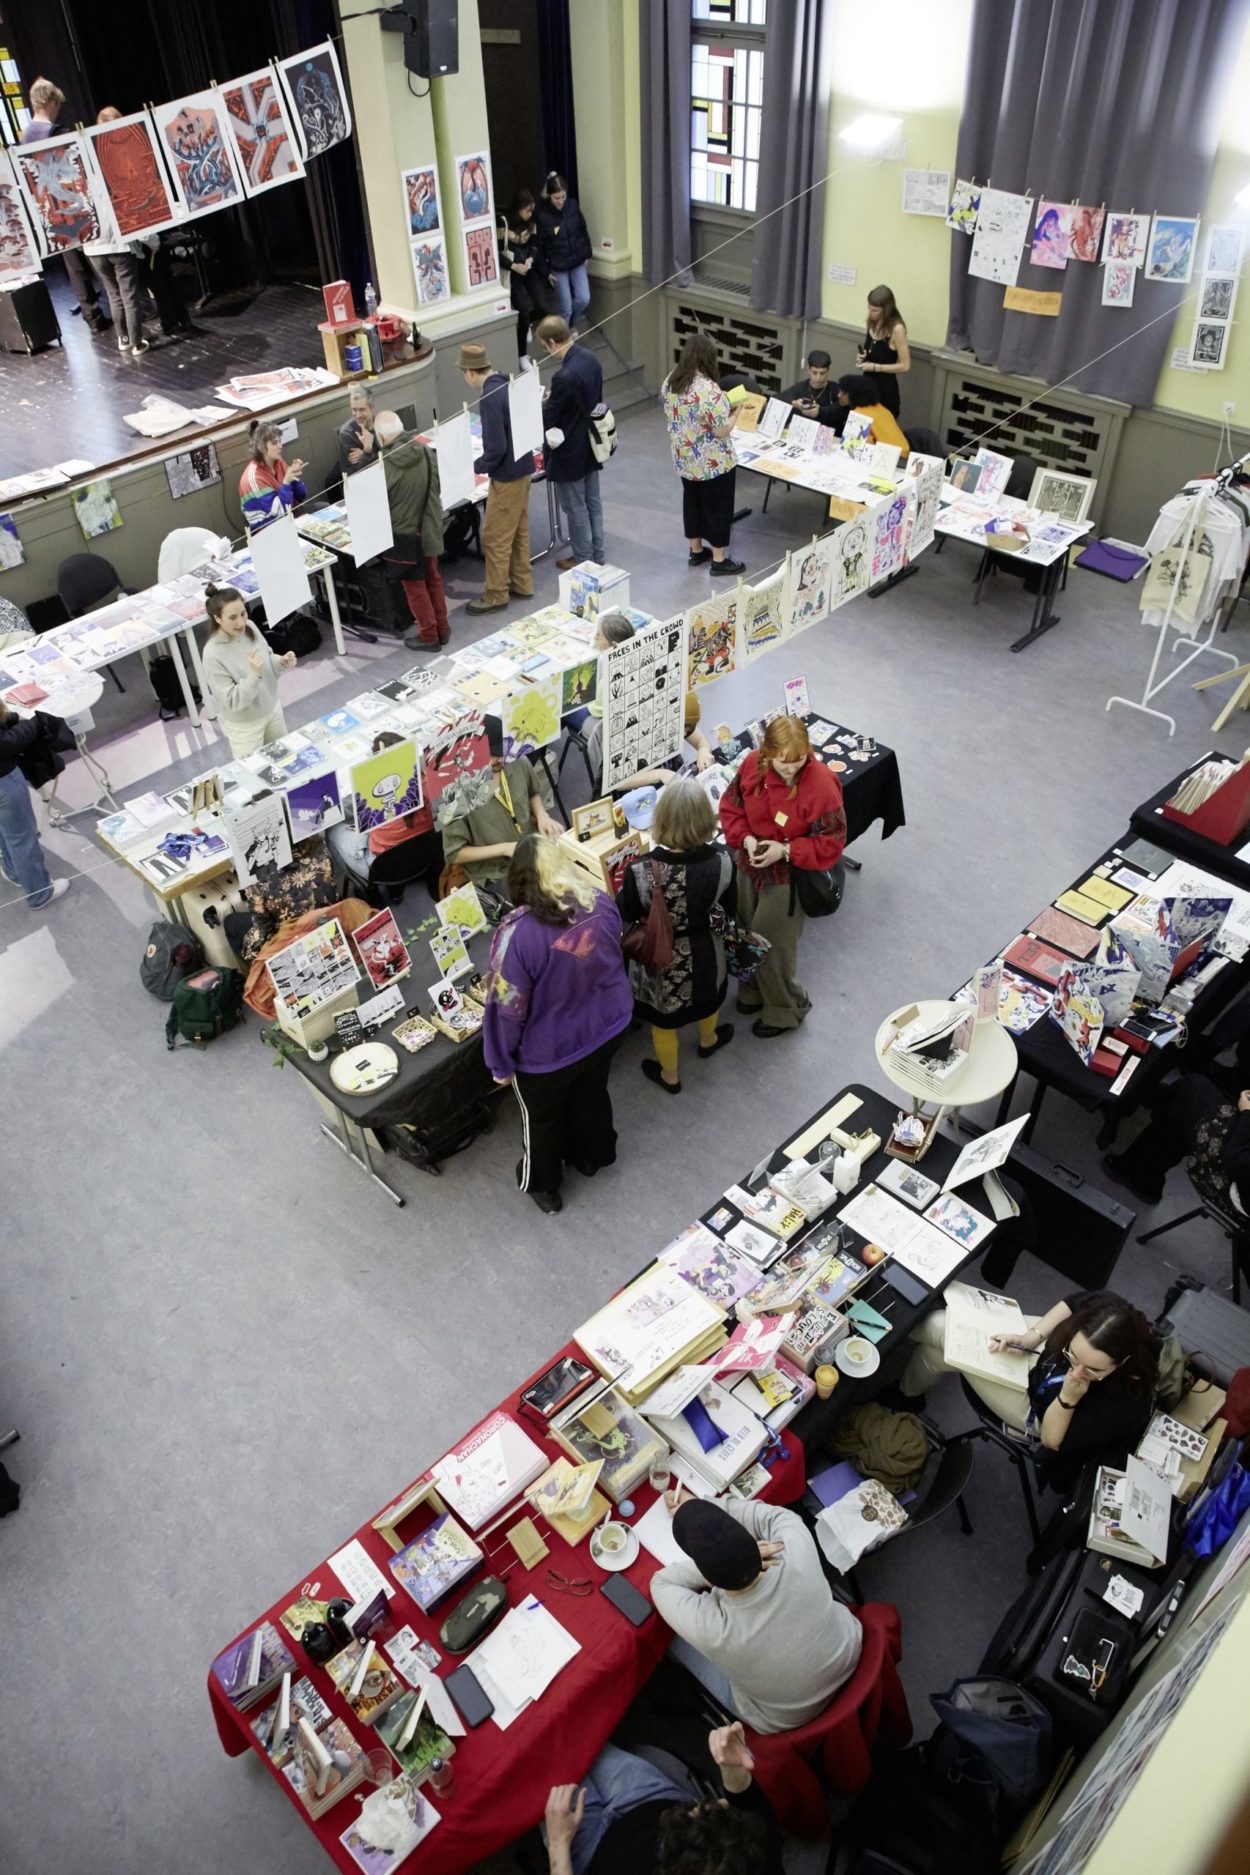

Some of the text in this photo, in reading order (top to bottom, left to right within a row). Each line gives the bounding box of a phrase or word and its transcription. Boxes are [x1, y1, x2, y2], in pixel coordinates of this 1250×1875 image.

[608, 619, 683, 661] FACES IN THE CROWD
[456, 1416, 506, 1463] CORONACHAN
